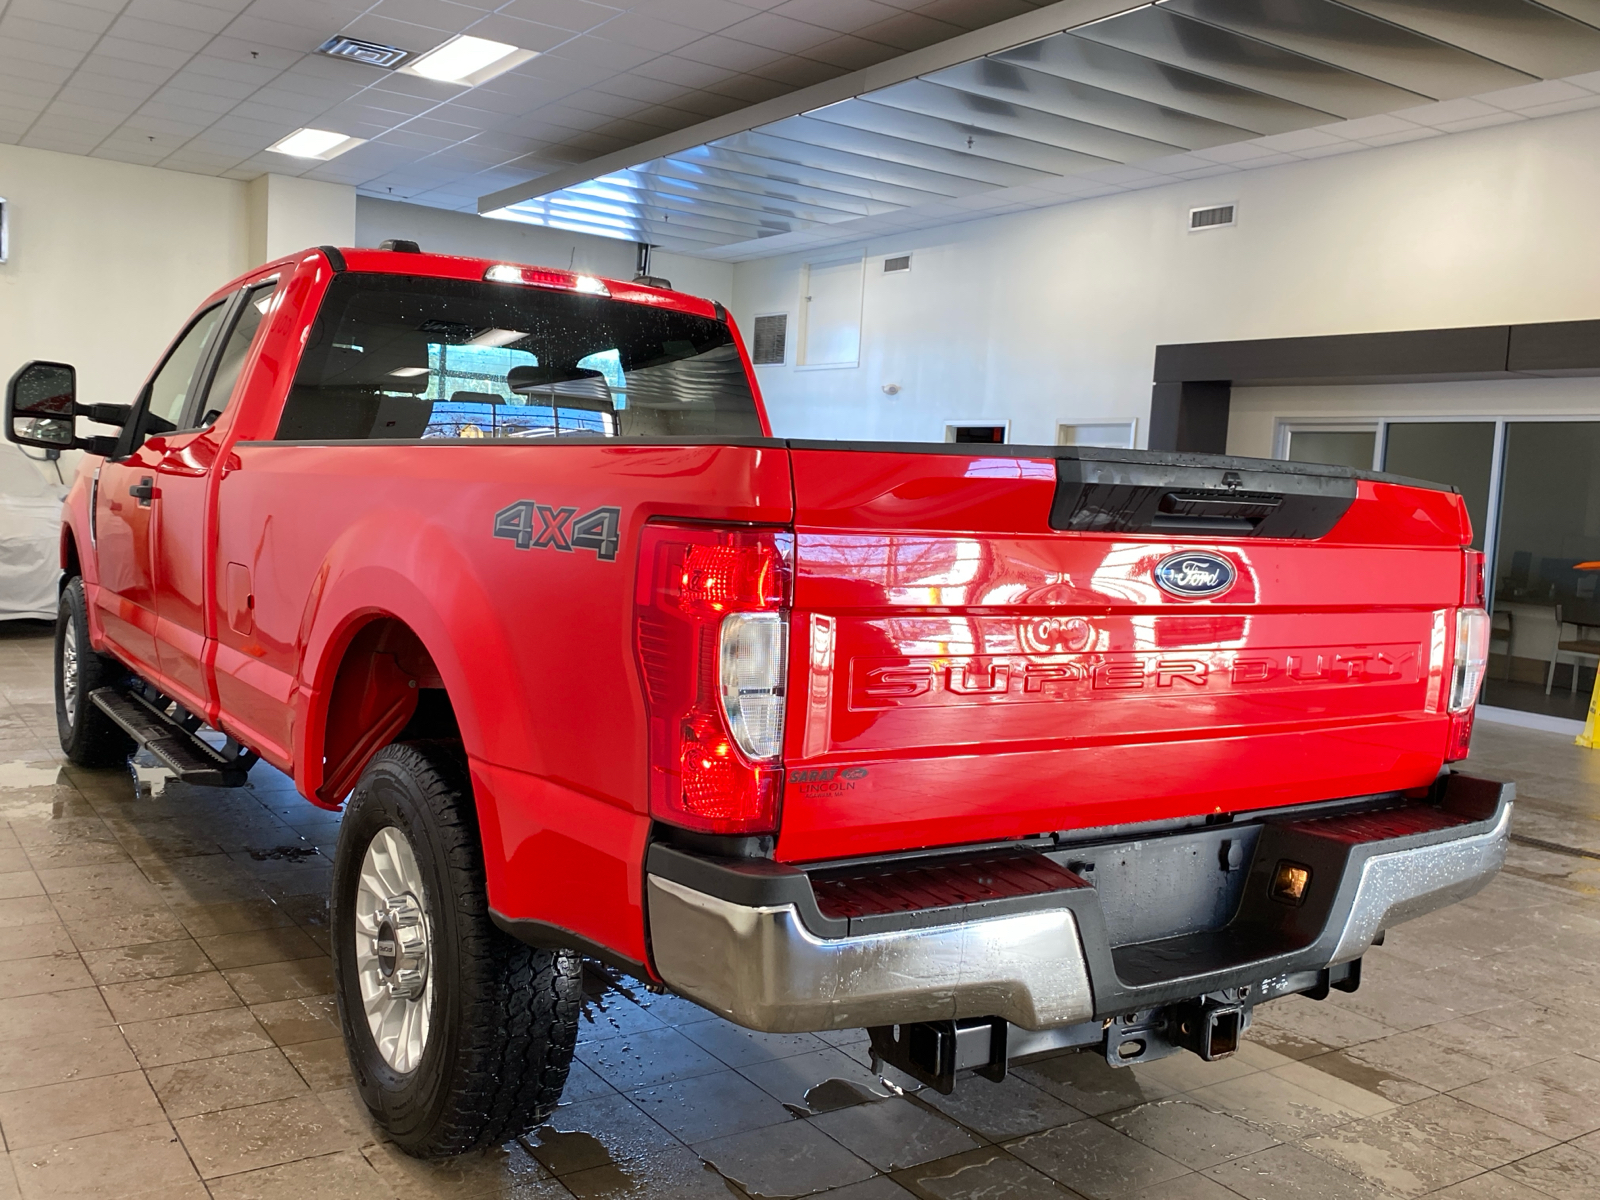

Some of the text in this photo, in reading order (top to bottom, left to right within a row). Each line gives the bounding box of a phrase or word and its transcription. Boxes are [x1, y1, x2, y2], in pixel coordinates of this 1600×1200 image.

[1177, 560, 1220, 587] Ford
[865, 651, 1415, 698] SUPER DUTY
[788, 768, 838, 783] SARAT
[799, 782, 856, 793] LINCOLN
